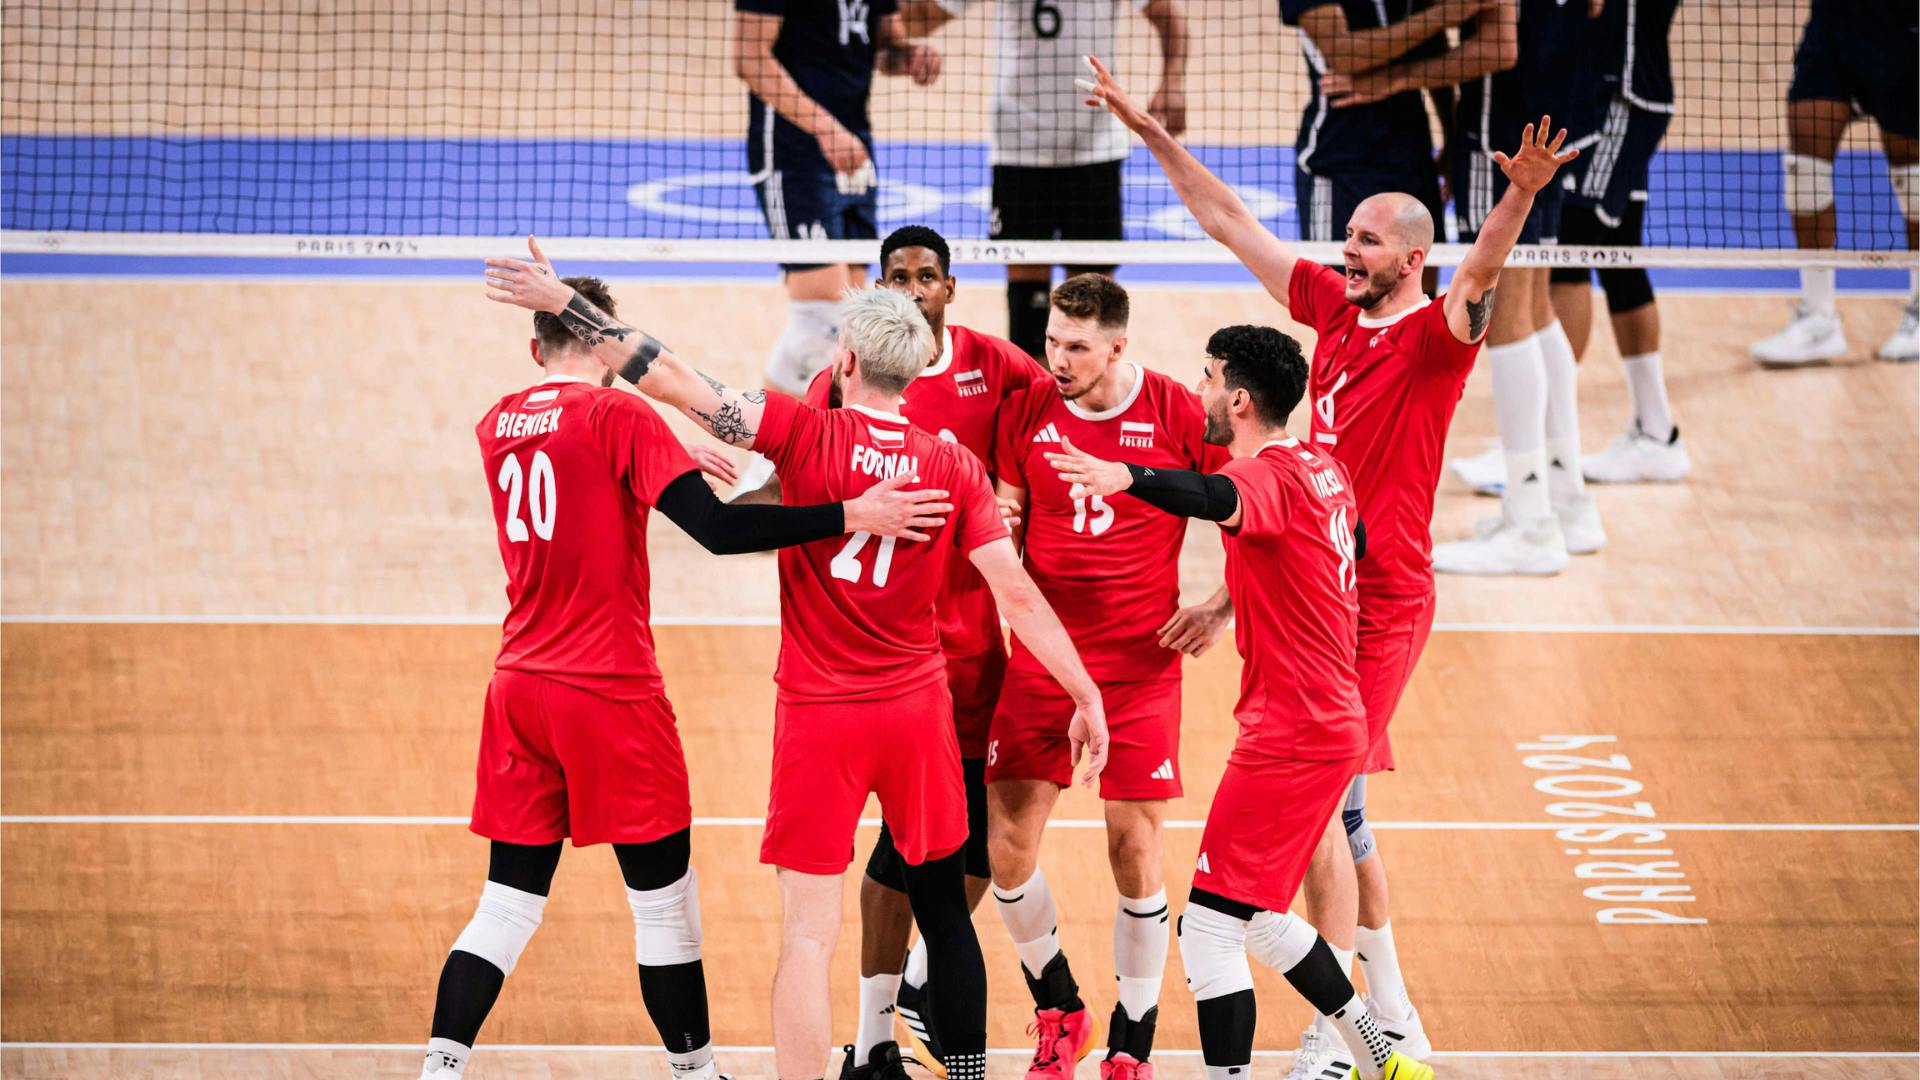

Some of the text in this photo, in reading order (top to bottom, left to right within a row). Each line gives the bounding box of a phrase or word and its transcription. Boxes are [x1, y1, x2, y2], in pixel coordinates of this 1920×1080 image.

[1513, 250, 1571, 263] PARIS
[495, 406, 563, 438] BIENIEK
[1119, 437, 1154, 449] POLSKA
[498, 450, 557, 543] 20
